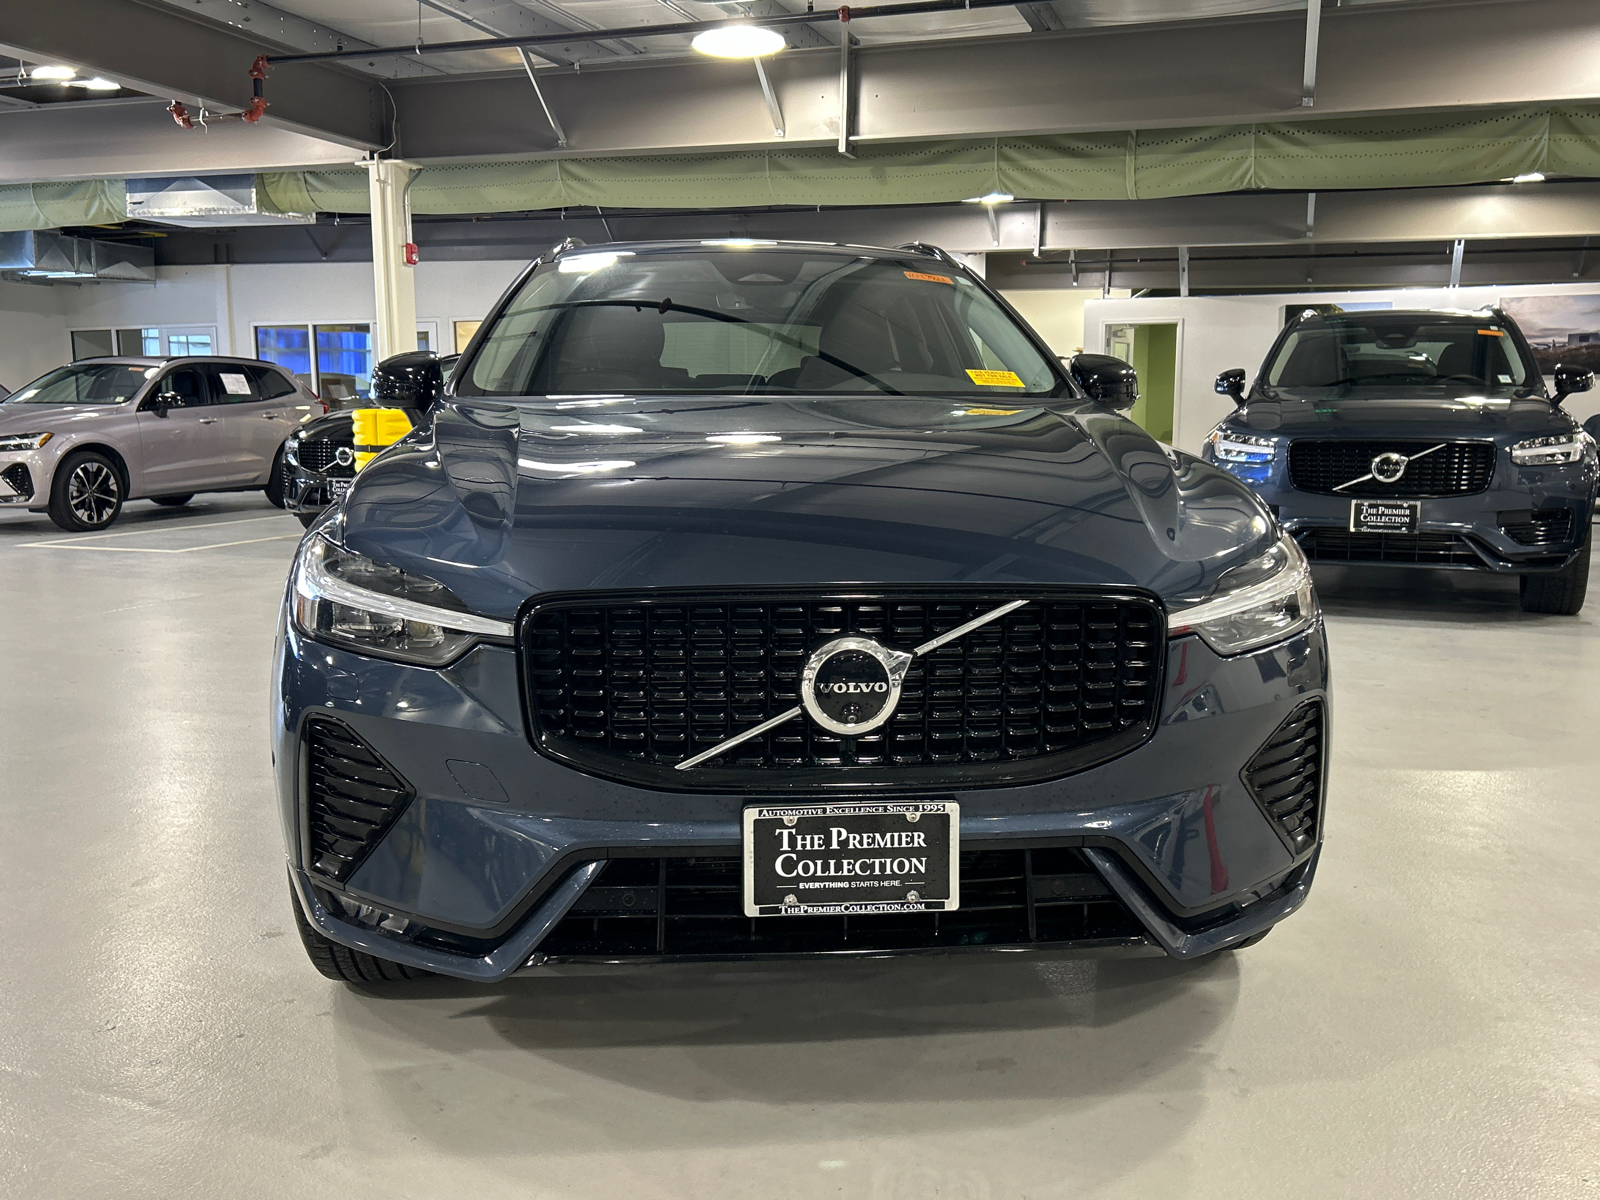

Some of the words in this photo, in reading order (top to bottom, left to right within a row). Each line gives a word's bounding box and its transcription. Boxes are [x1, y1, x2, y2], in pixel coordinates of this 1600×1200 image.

[1361, 506, 1377, 514] THE
[1378, 506, 1410, 515] PREMIER
[1360, 513, 1410, 523] COLLECTION
[816, 682, 888, 693] VOLVO
[760, 808, 824, 817] AUTOMOTIVE
[826, 806, 885, 815] EXCELLENCE
[886, 804, 916, 813] SINCE
[918, 803, 944, 812] 1995
[775, 827, 826, 851] THE
[829, 827, 928, 850] PREMIER
[774, 853, 928, 878] COLLECTION
[798, 881, 849, 889] EVERYTHING
[850, 880, 879, 888] STARTS
[880, 879, 903, 887] HERE.
